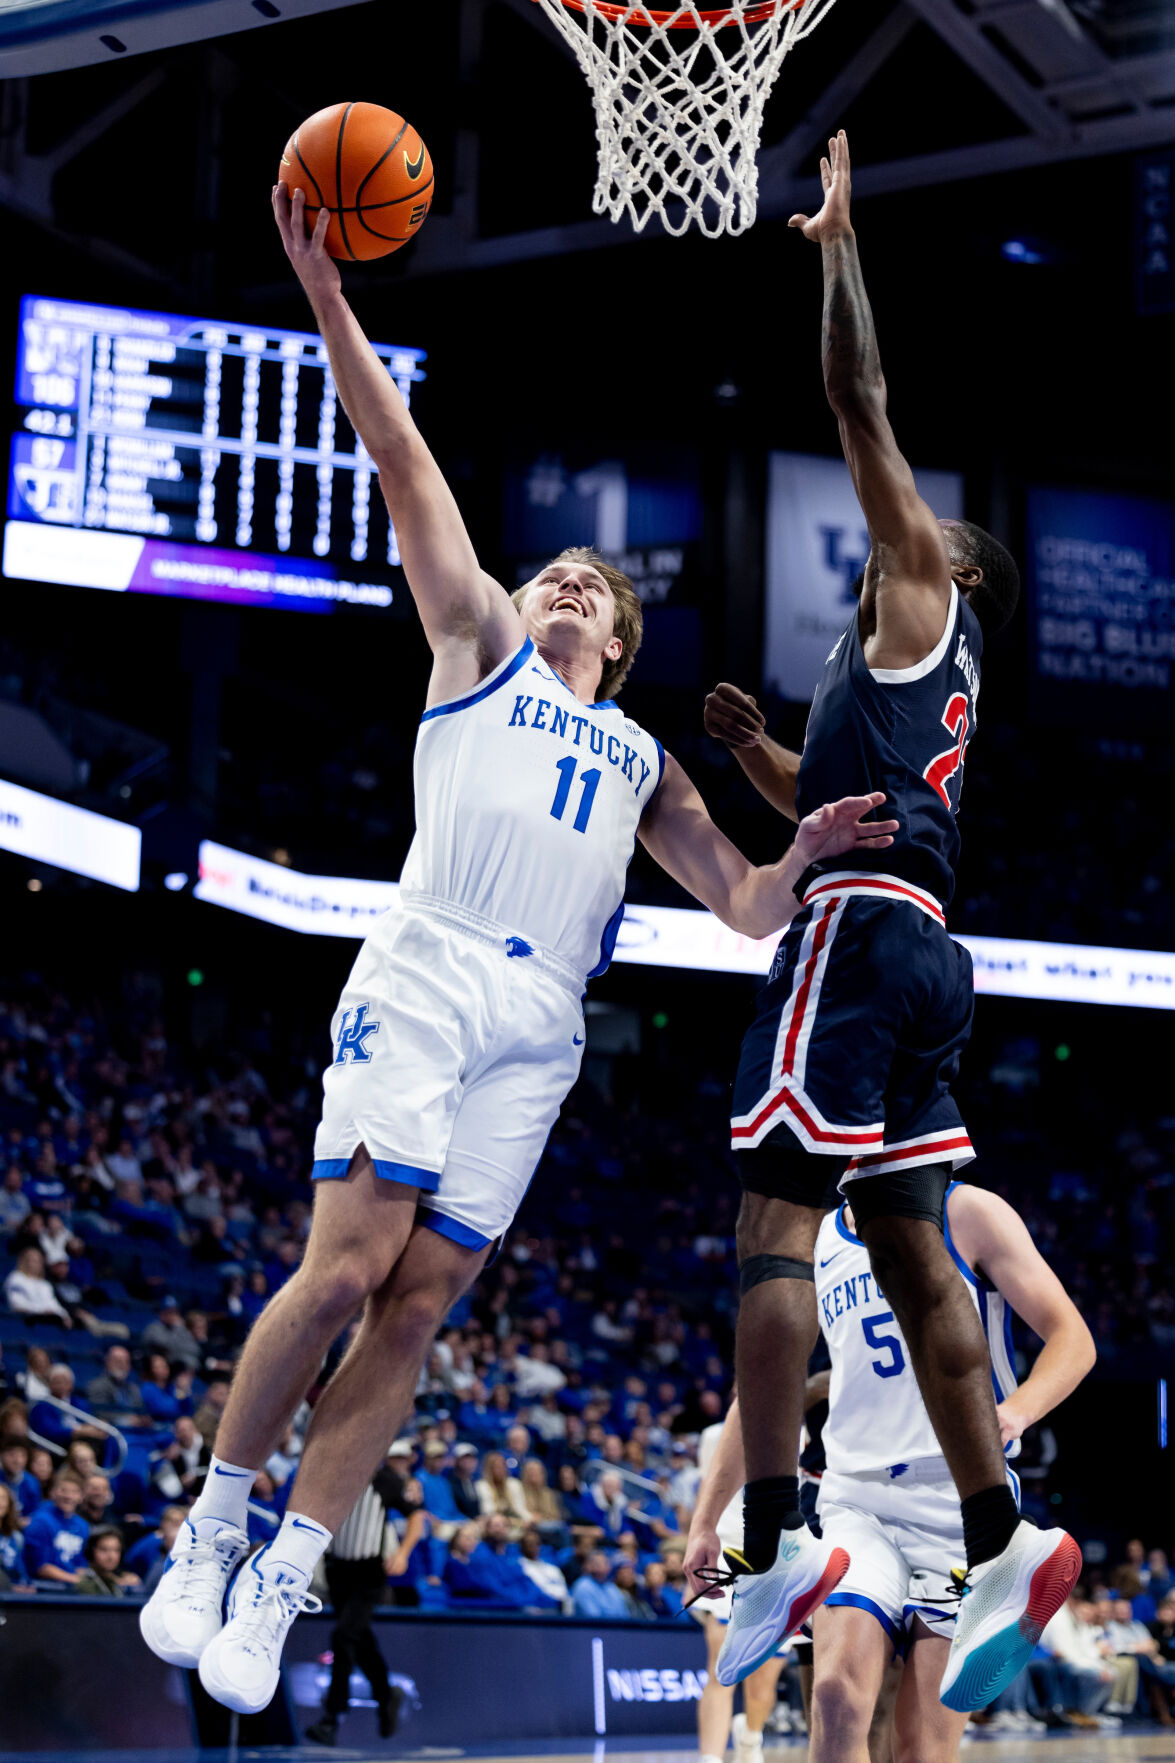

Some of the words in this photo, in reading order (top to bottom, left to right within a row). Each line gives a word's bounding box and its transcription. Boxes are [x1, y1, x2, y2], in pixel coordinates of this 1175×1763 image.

[508, 695, 650, 797] KENTUCKY
[922, 692, 970, 812] 2
[550, 755, 602, 834] 11
[334, 1001, 380, 1067] UK
[862, 1312, 906, 1378] 5
